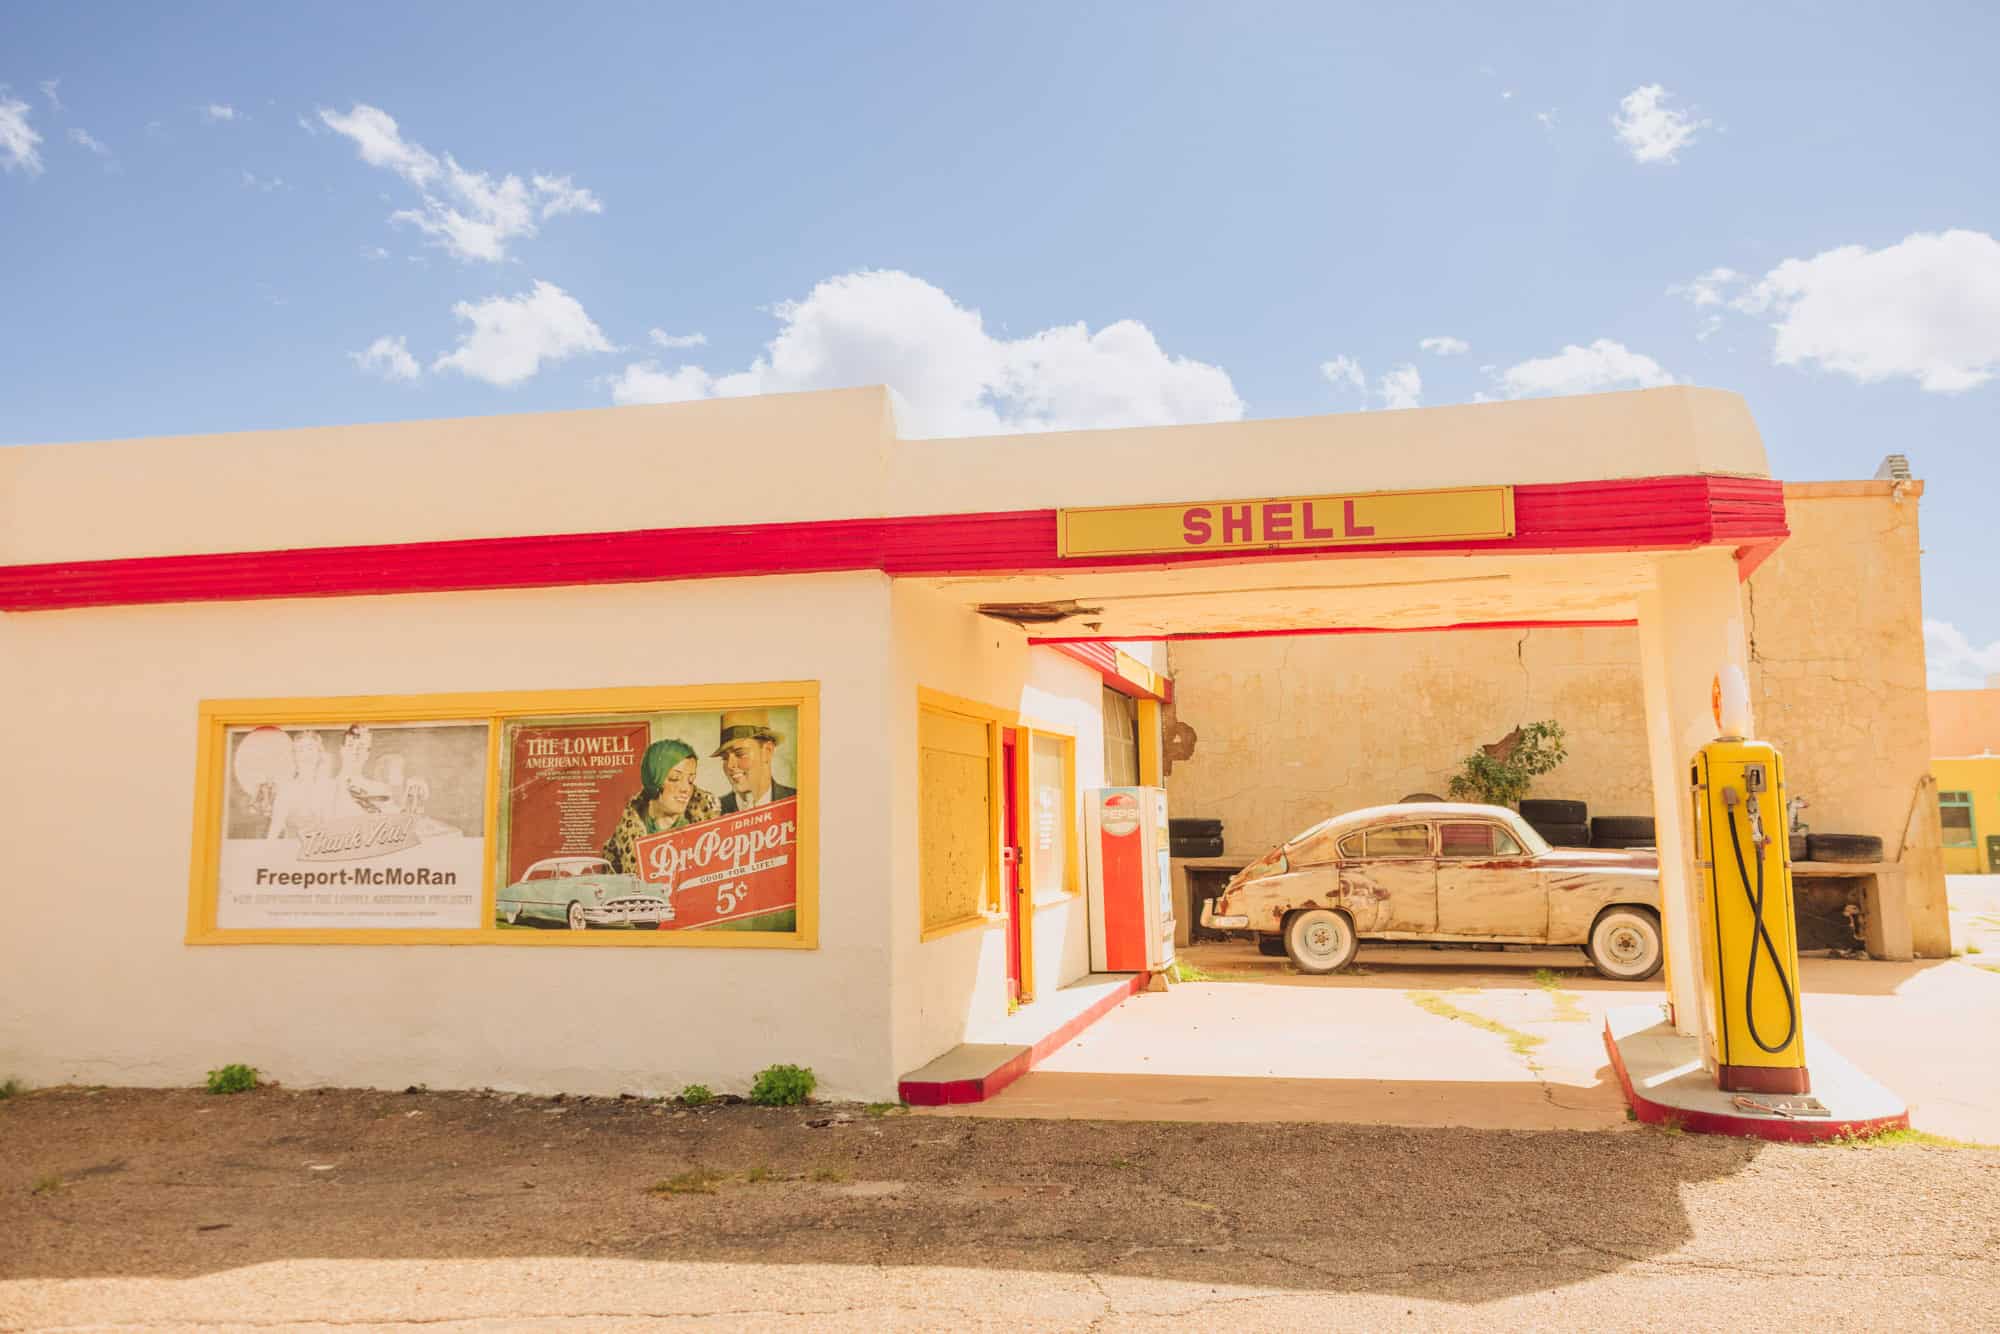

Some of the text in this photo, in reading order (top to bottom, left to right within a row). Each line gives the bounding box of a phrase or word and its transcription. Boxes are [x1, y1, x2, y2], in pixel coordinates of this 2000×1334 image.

[1182, 499, 1376, 545] SHELL
[526, 735, 634, 756] THE LOWELL
[525, 754, 634, 769] AMERICANA PROJECT
[731, 811, 773, 832] DRINK
[255, 867, 457, 889] Freeport-McMoRan
[699, 873, 724, 883] GOOD
[728, 867, 746, 877] FOR
[716, 881, 748, 915] 5¢
